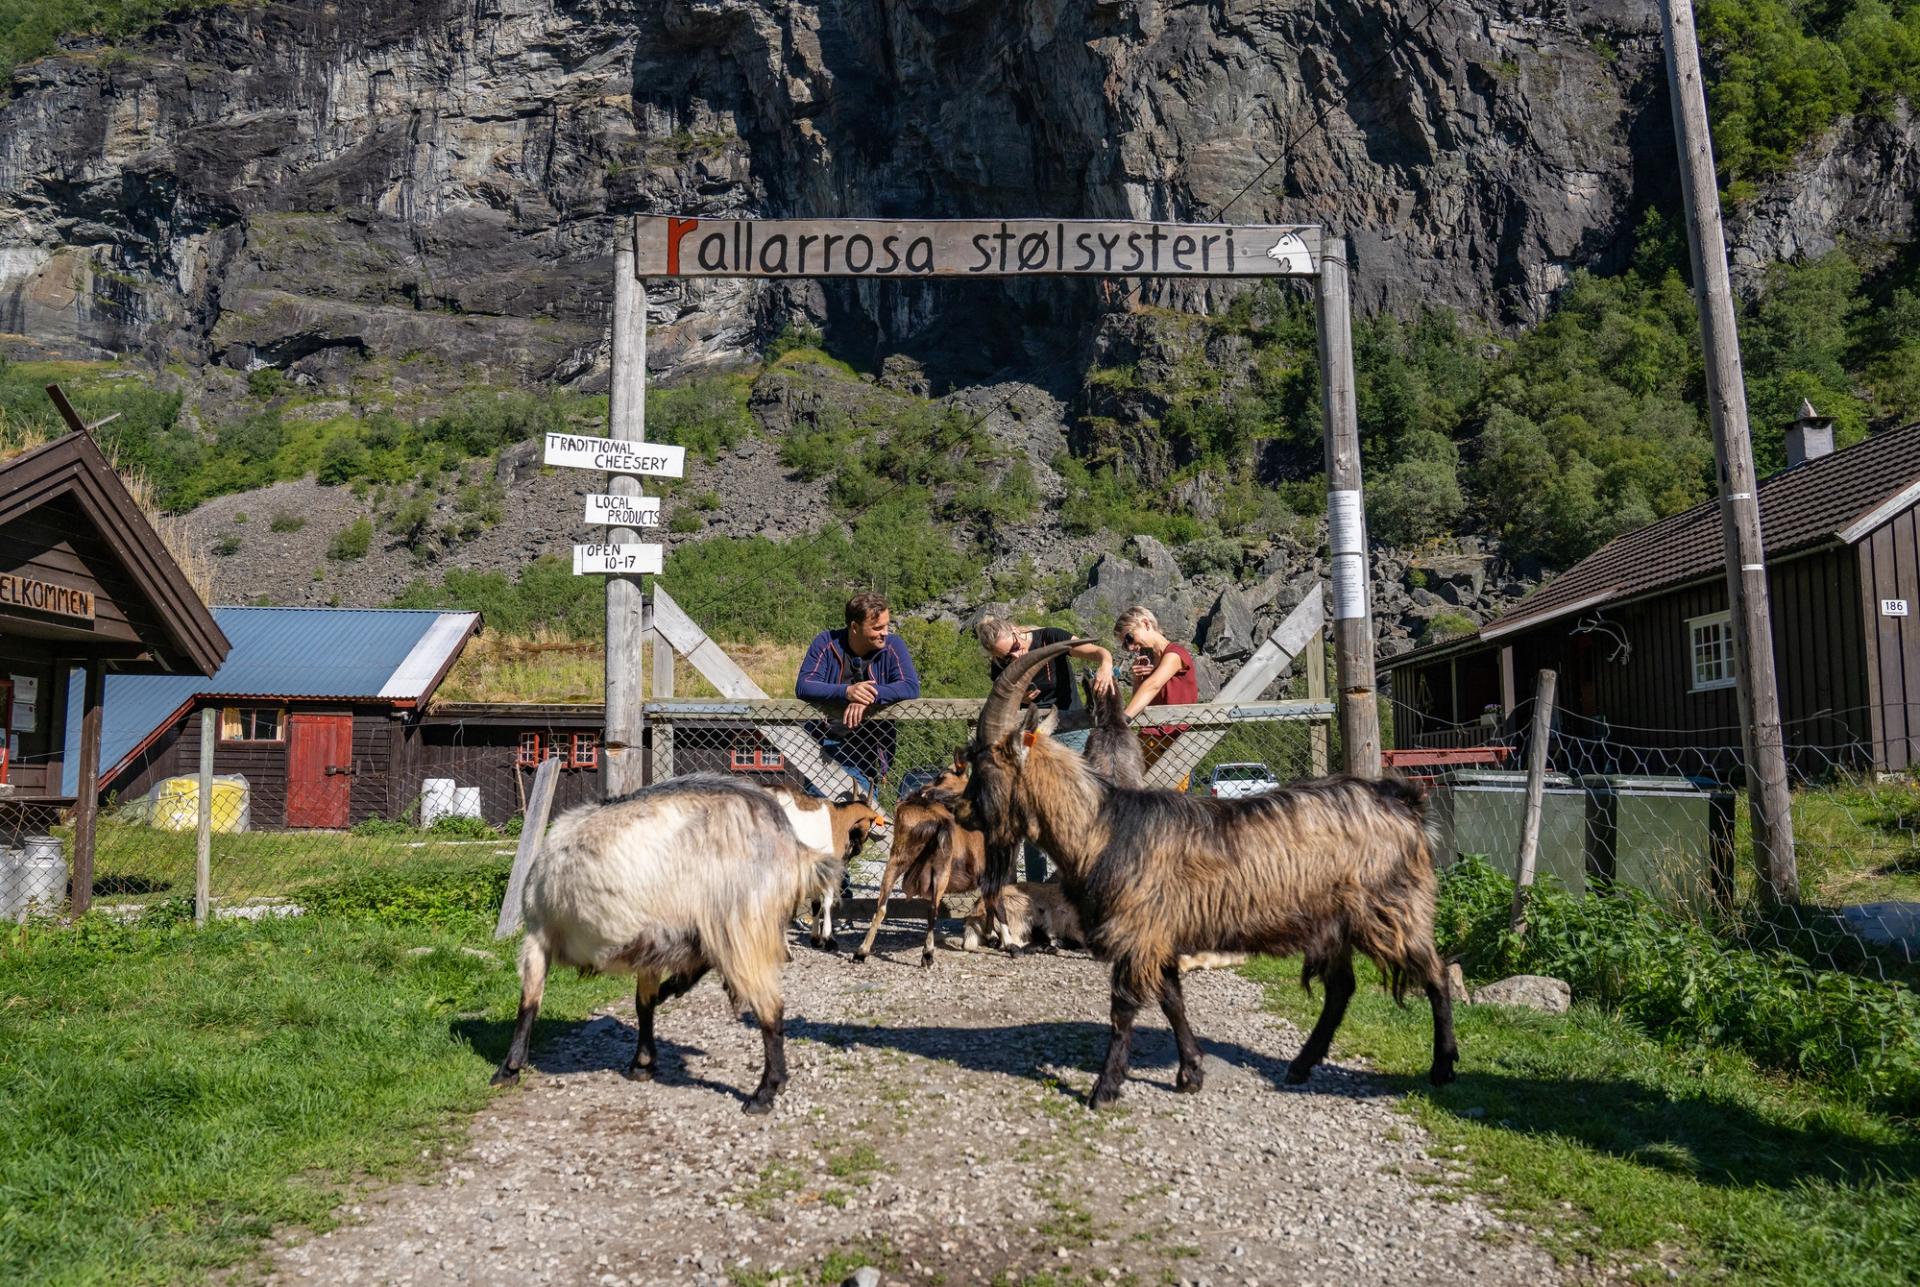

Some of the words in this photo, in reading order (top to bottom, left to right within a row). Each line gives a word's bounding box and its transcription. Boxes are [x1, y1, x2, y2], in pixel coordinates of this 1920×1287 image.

[666, 217, 935, 276] rallarrosa
[969, 222, 1235, 272] stølsysteri
[547, 434, 635, 456] TRADITIONAL
[594, 453, 668, 471] CHEESERY
[595, 496, 633, 510] LOCAL
[607, 509, 660, 525] PRODUCTS
[586, 544, 621, 557] OPEN
[604, 555, 636, 569] 10-17
[1885, 601, 1903, 610] 186
